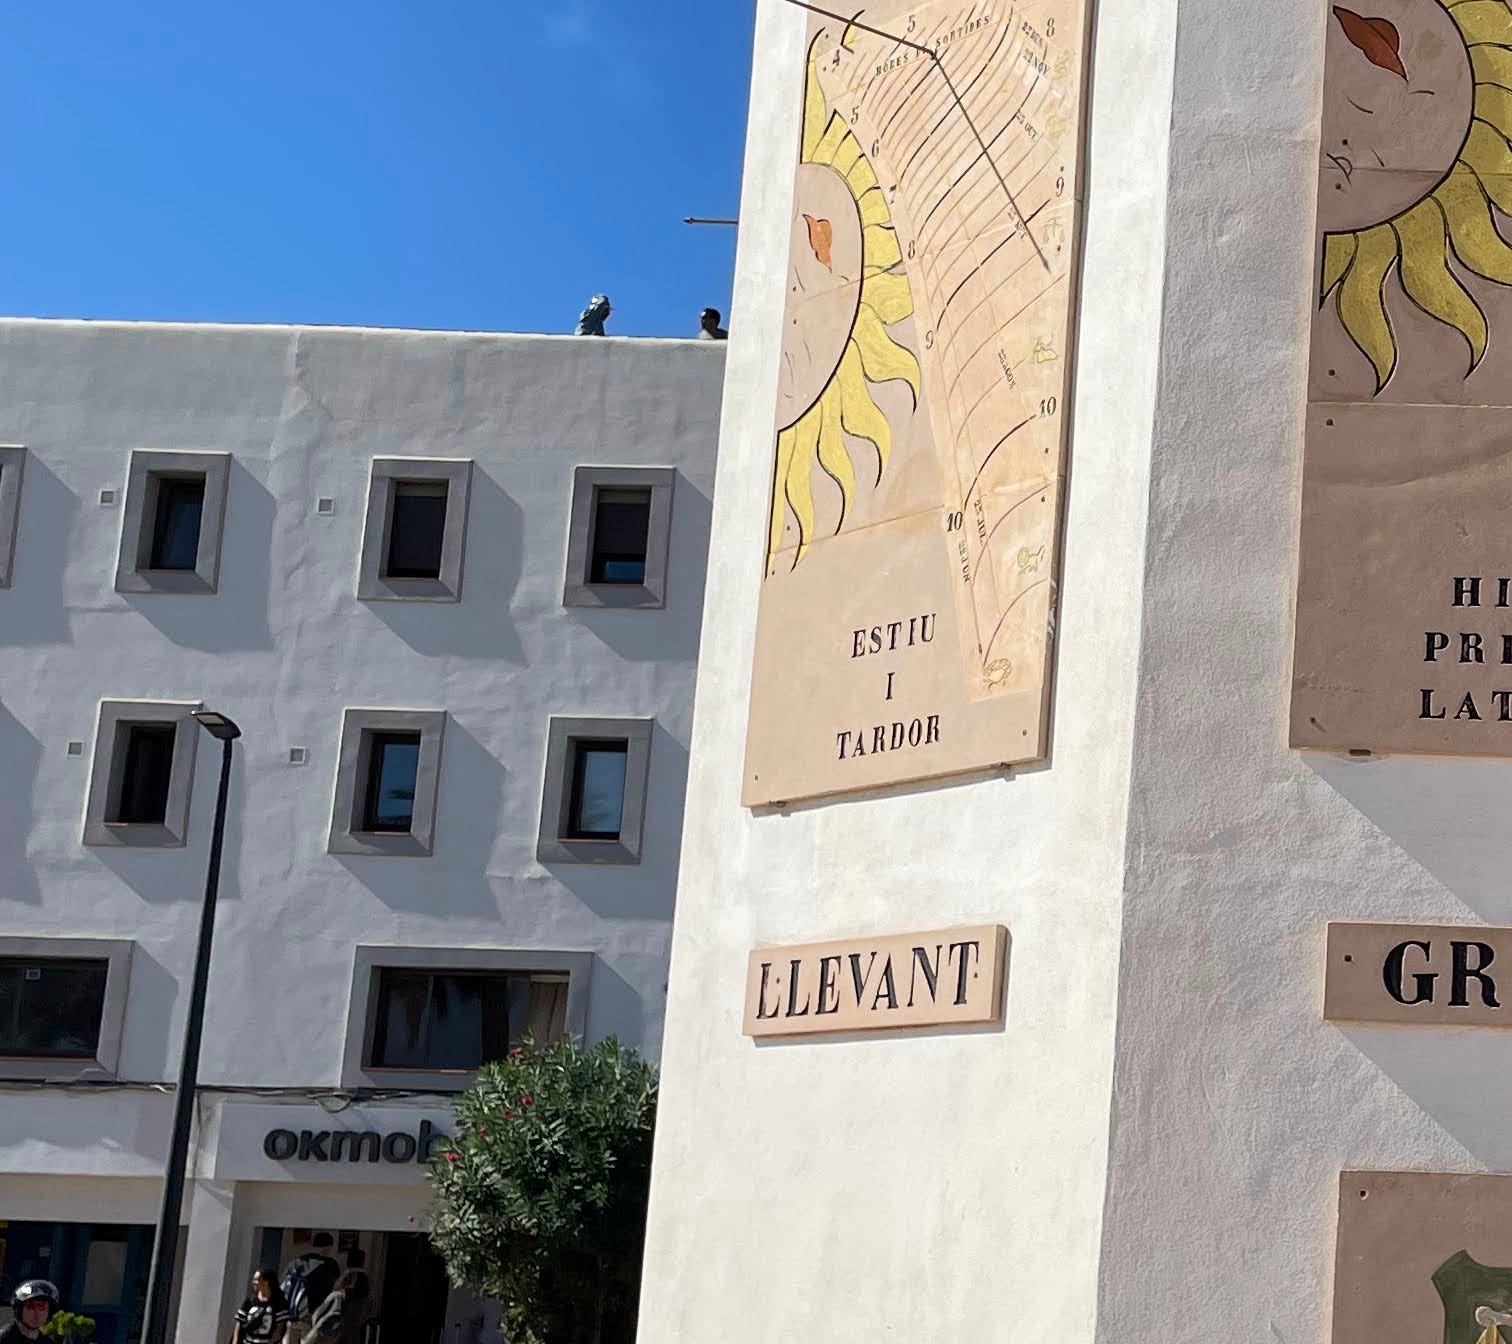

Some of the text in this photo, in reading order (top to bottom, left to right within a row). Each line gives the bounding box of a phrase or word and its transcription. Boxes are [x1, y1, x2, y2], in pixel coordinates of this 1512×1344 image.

[907, 15, 915, 33] 5
[1046, 17, 1055, 37] 8
[851, 106, 859, 124] 5
[872, 139, 879, 157] 6
[889, 184, 897, 205] 7
[1056, 176, 1064, 197] 9
[908, 240, 915, 260] 8
[925, 330, 934, 350] 9
[1039, 396, 1057, 417] 10
[947, 511, 963, 533] 10
[851, 613, 938, 659] ESTIU
[886, 671, 895, 701] I
[836, 713, 941, 761] TARDOR
[756, 940, 980, 1020] LLEVANT
